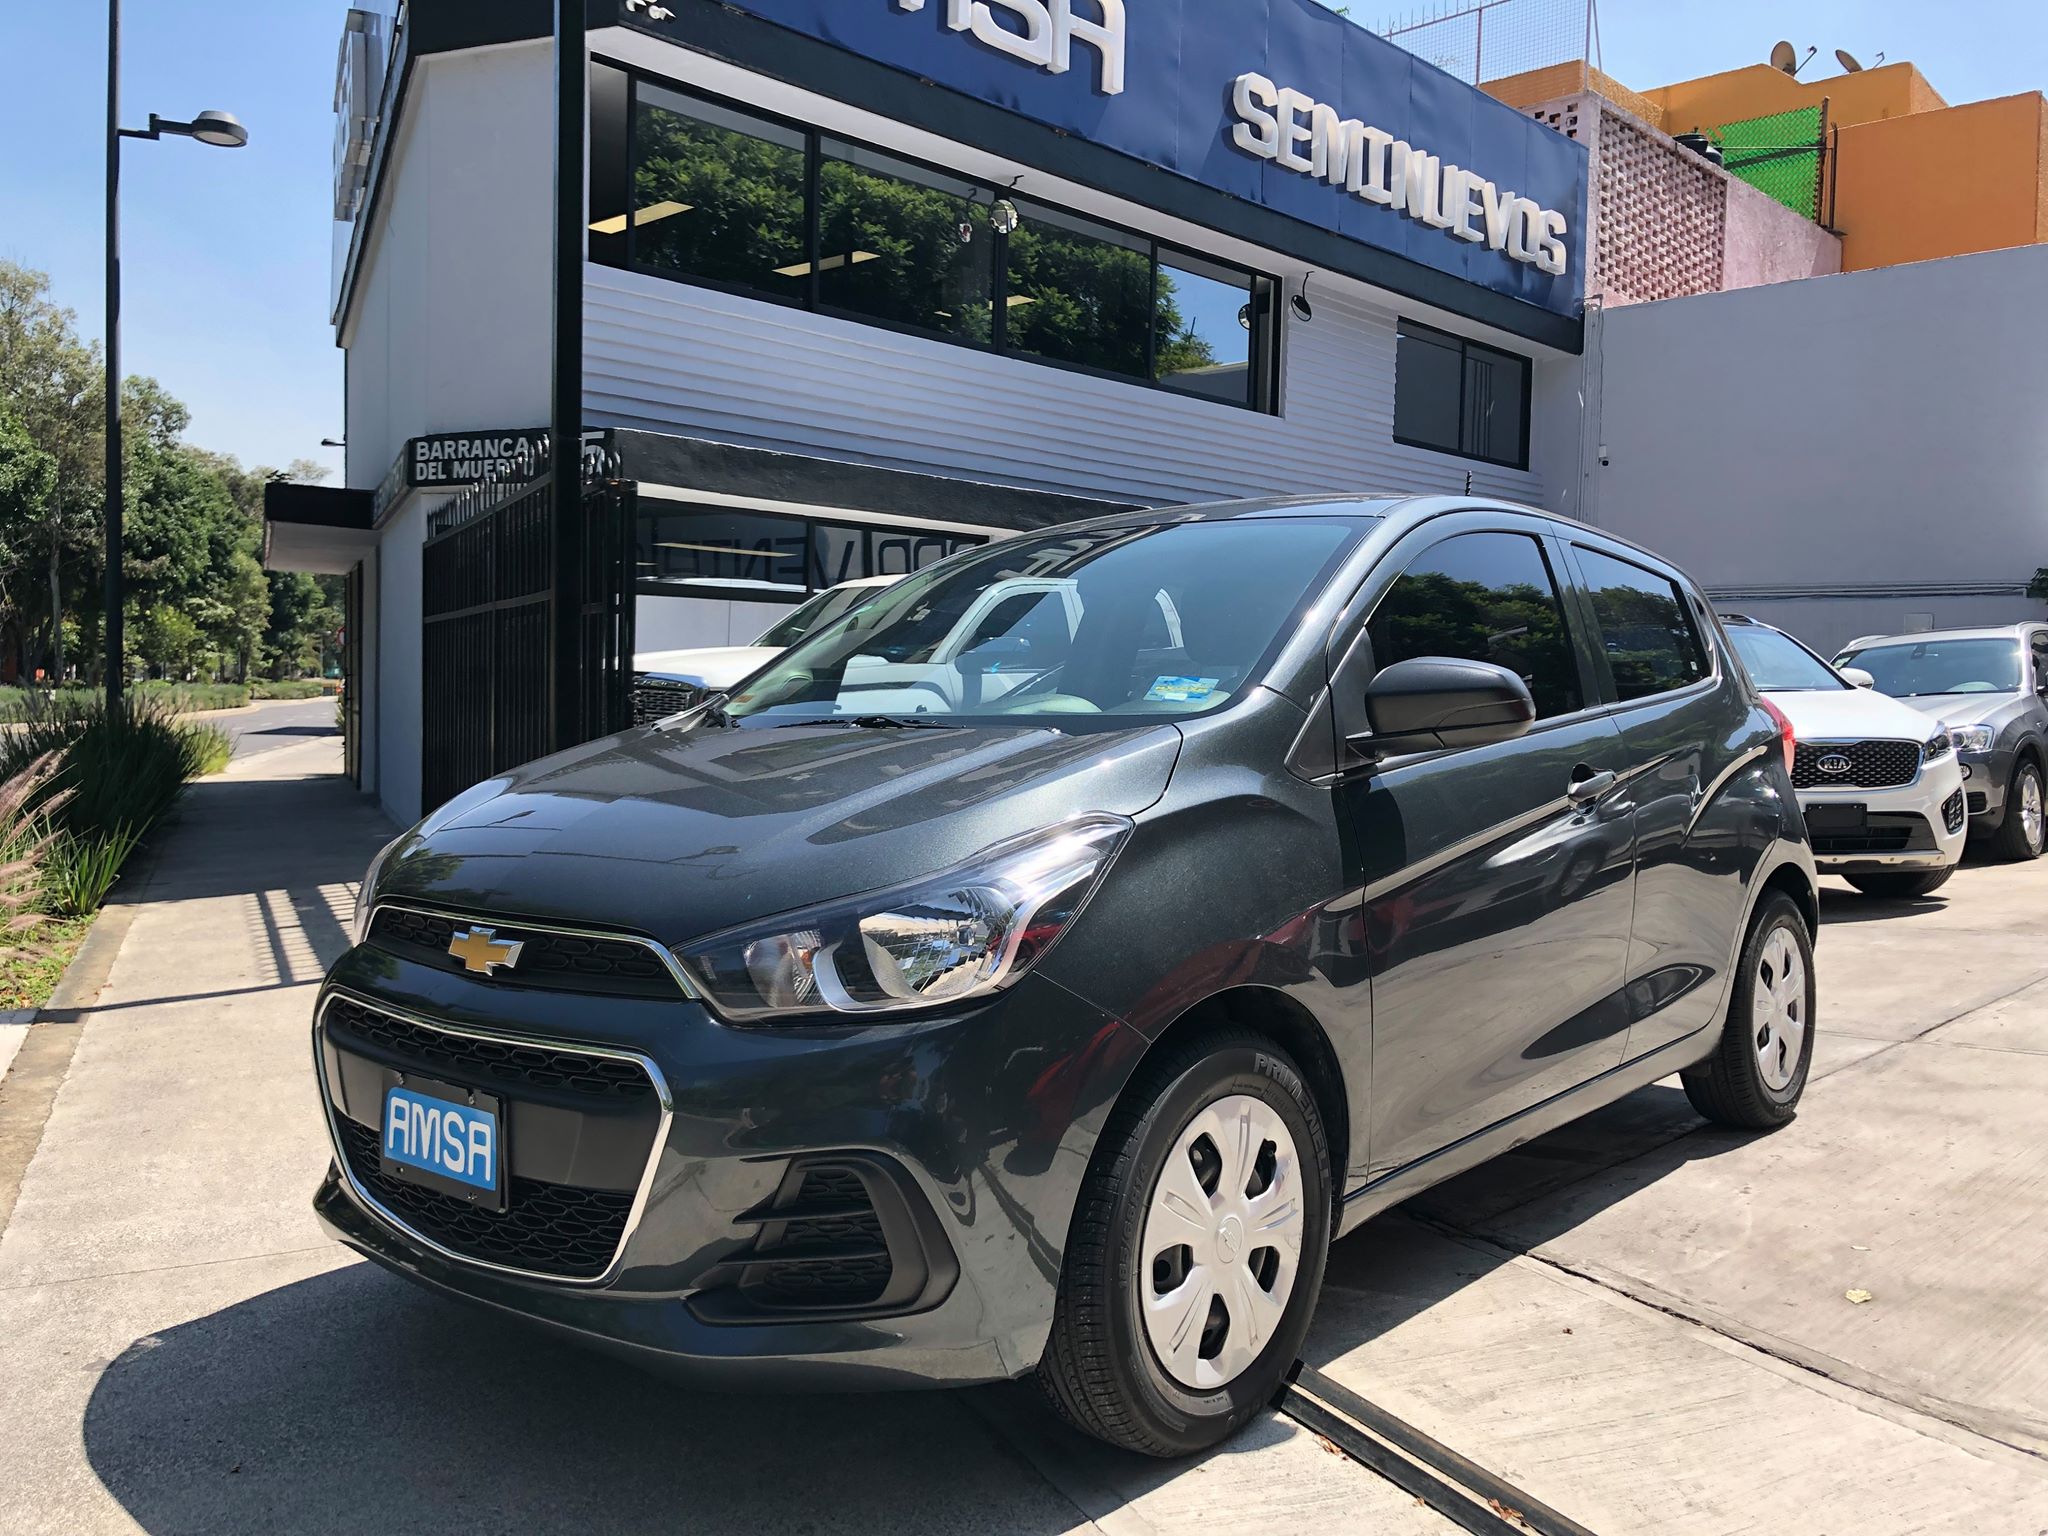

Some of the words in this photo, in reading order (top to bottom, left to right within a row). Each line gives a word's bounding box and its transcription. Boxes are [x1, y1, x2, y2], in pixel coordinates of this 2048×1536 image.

[1233, 71, 1568, 276] SEMINUEVOS
[415, 437, 529, 461] BARRANCA
[415, 461, 447, 481] DEL
[1822, 757, 1848, 770] KIA
[388, 1096, 491, 1182] AMSA
